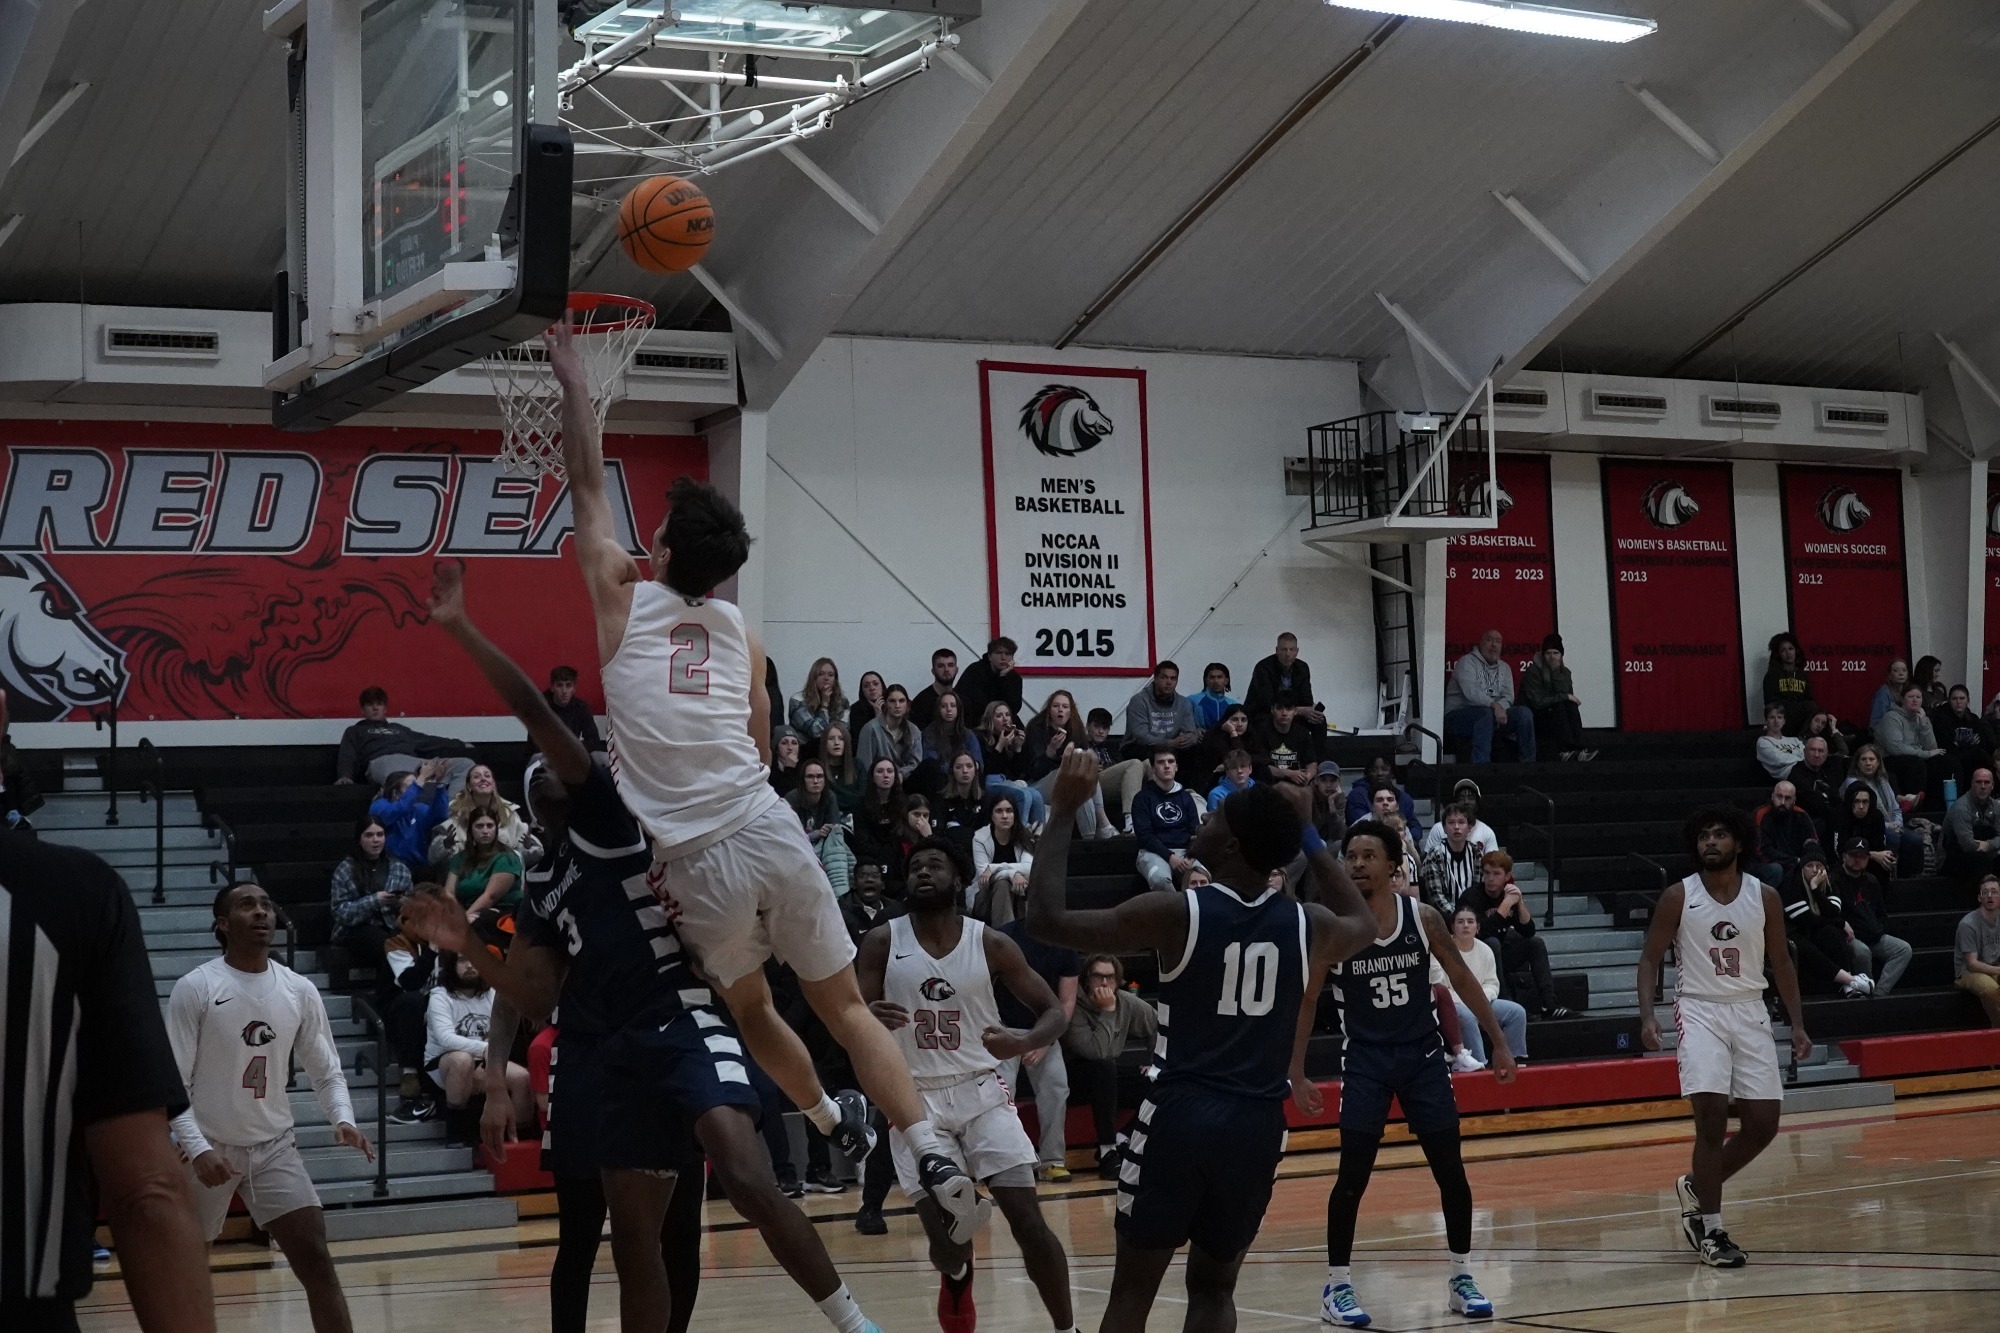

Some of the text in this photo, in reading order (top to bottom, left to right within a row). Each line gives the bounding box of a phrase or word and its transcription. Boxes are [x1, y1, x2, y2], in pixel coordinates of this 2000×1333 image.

[1041, 478, 1096, 494] MEN'S
[0, 446, 323, 556] RED
[1015, 496, 1125, 515] BASKETBALL
[1041, 533, 1100, 550] NCCAA
[1470, 535, 1537, 547] BASKETBALL
[1617, 539, 1727, 551] WOMEN'S BASKETBALL
[1804, 543, 1887, 555] WOMEN'S SOCCER
[1025, 553, 1119, 569] DIVISION II
[1030, 572, 1115, 589] NATIONAL
[1472, 568, 1544, 580] 2018 2023
[1620, 571, 1647, 582] 2013
[1799, 573, 1823, 584] 2012
[1021, 592, 1127, 608] CHAMPIONS
[1035, 628, 1115, 657] 2015
[669, 623, 710, 695] 2
[1625, 661, 1653, 672] 2013
[1803, 660, 1866, 671] 2011 2012
[556, 907, 582, 957] 3
[1352, 952, 1420, 975] BRANDYWINE
[1709, 947, 1740, 977] 13
[1217, 941, 1280, 1016] 10
[1370, 972, 1410, 1009] 35
[914, 1009, 960, 1050] 25
[242, 1055, 267, 1099] 4
